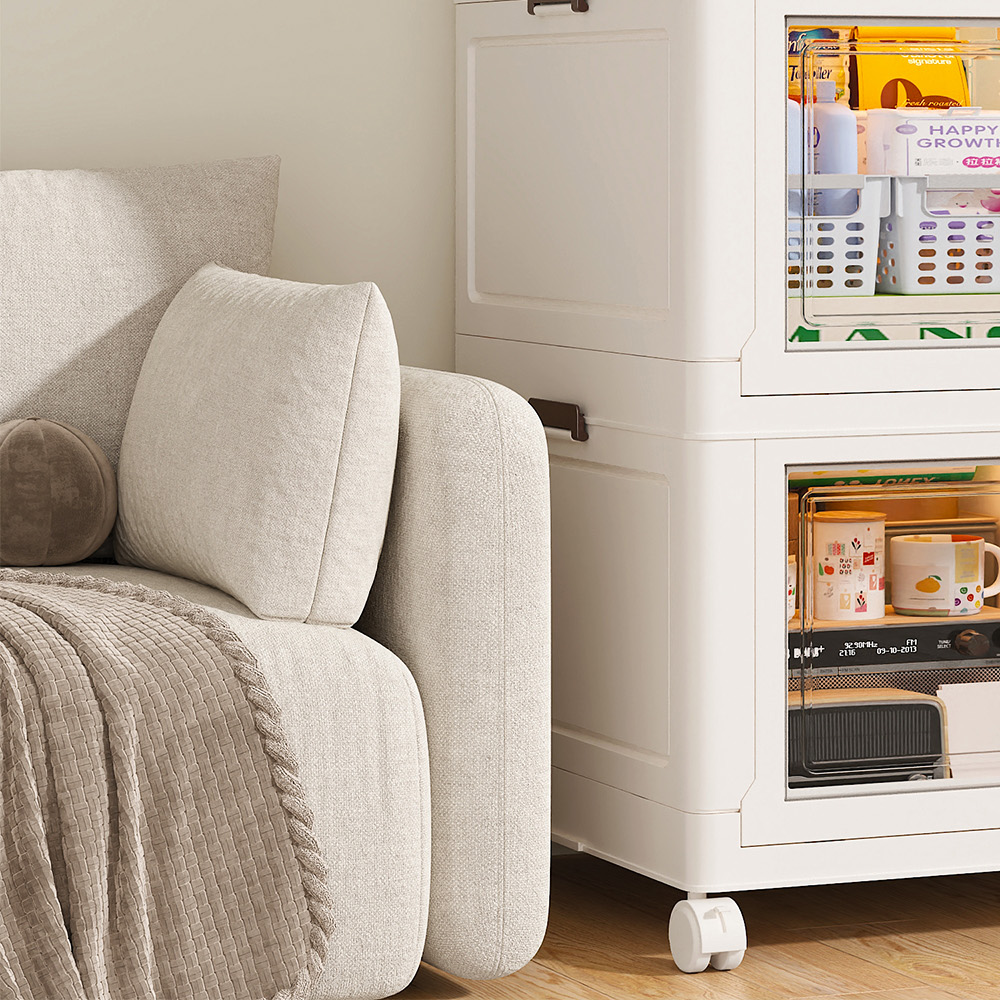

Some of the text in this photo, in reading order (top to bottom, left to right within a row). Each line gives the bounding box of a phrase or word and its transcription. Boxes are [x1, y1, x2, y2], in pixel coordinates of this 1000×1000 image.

[908, 58, 952, 66] signature
[902, 98, 927, 108] fresh
[929, 125, 998, 135] HAPPY
